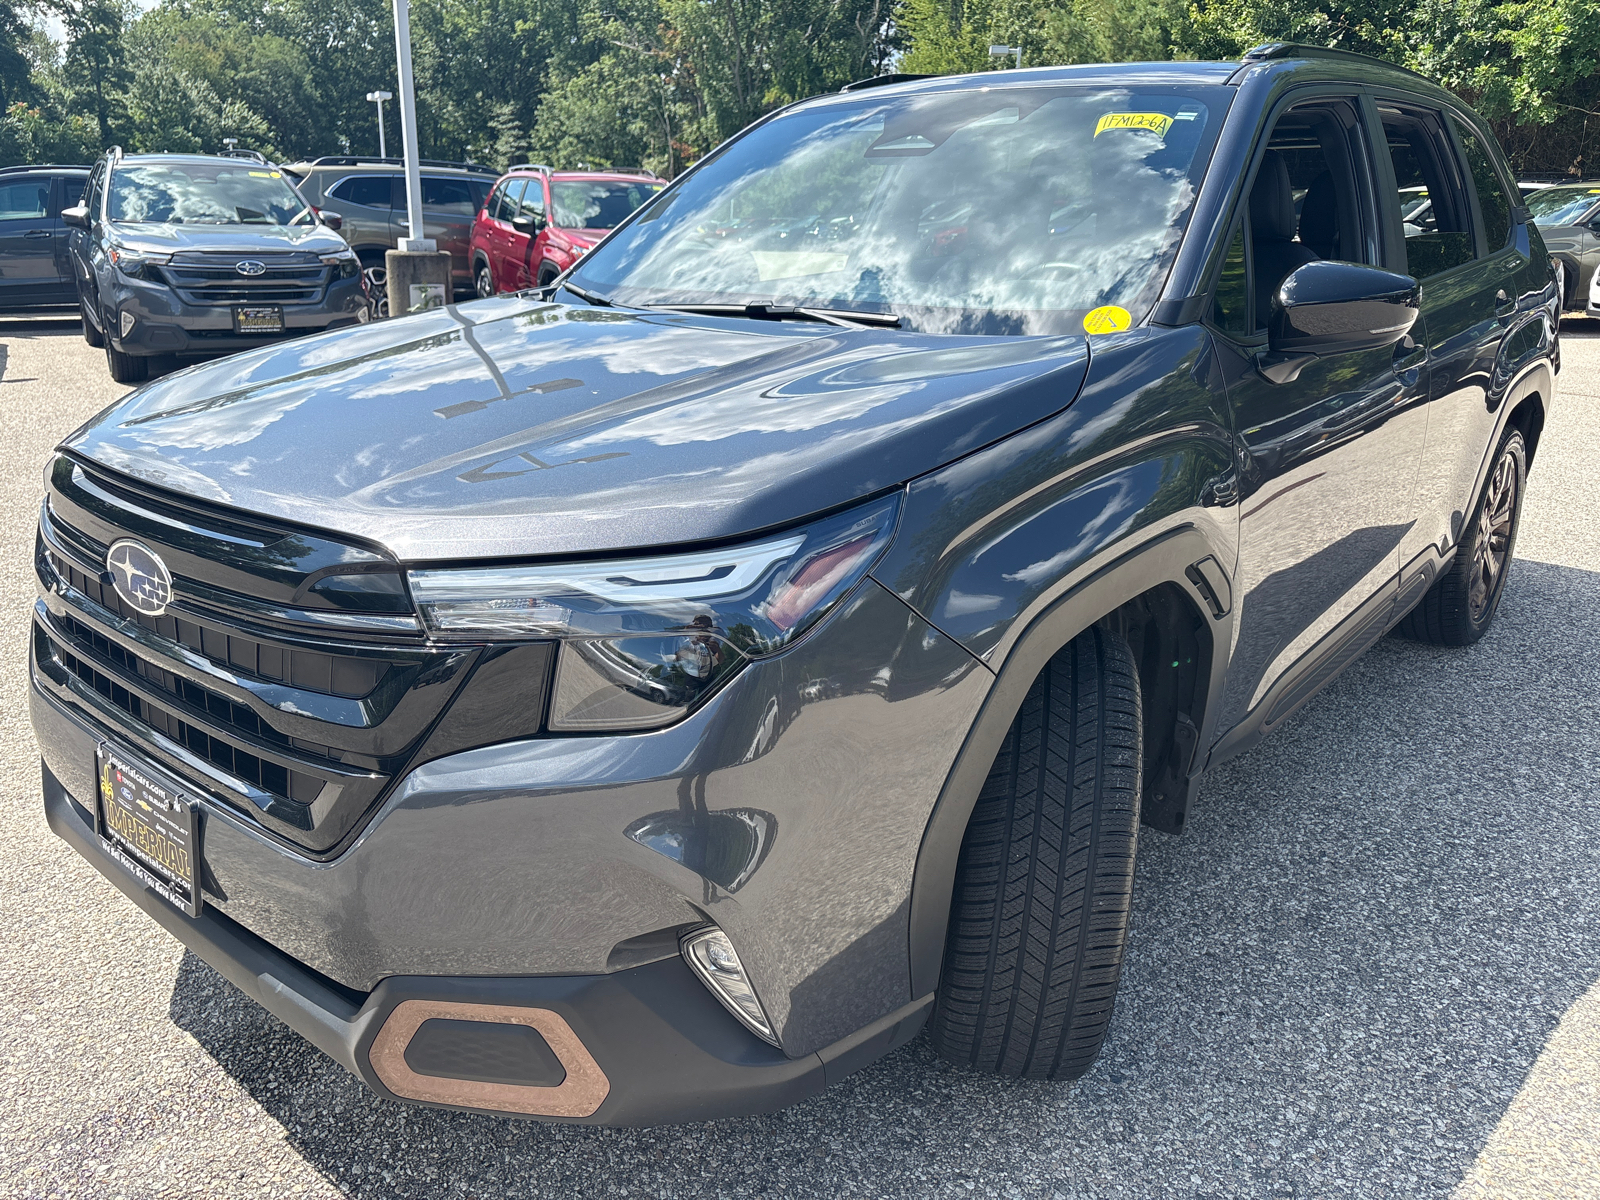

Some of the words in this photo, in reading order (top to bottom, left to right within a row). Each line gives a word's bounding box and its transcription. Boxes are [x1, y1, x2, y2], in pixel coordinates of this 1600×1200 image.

[121, 776, 136, 791] TOYOTA
[153, 810, 188, 836] CHEVROLET
[105, 796, 191, 881] IMPERIAL
[143, 872, 155, 888] You
[155, 881, 169, 902] Save
